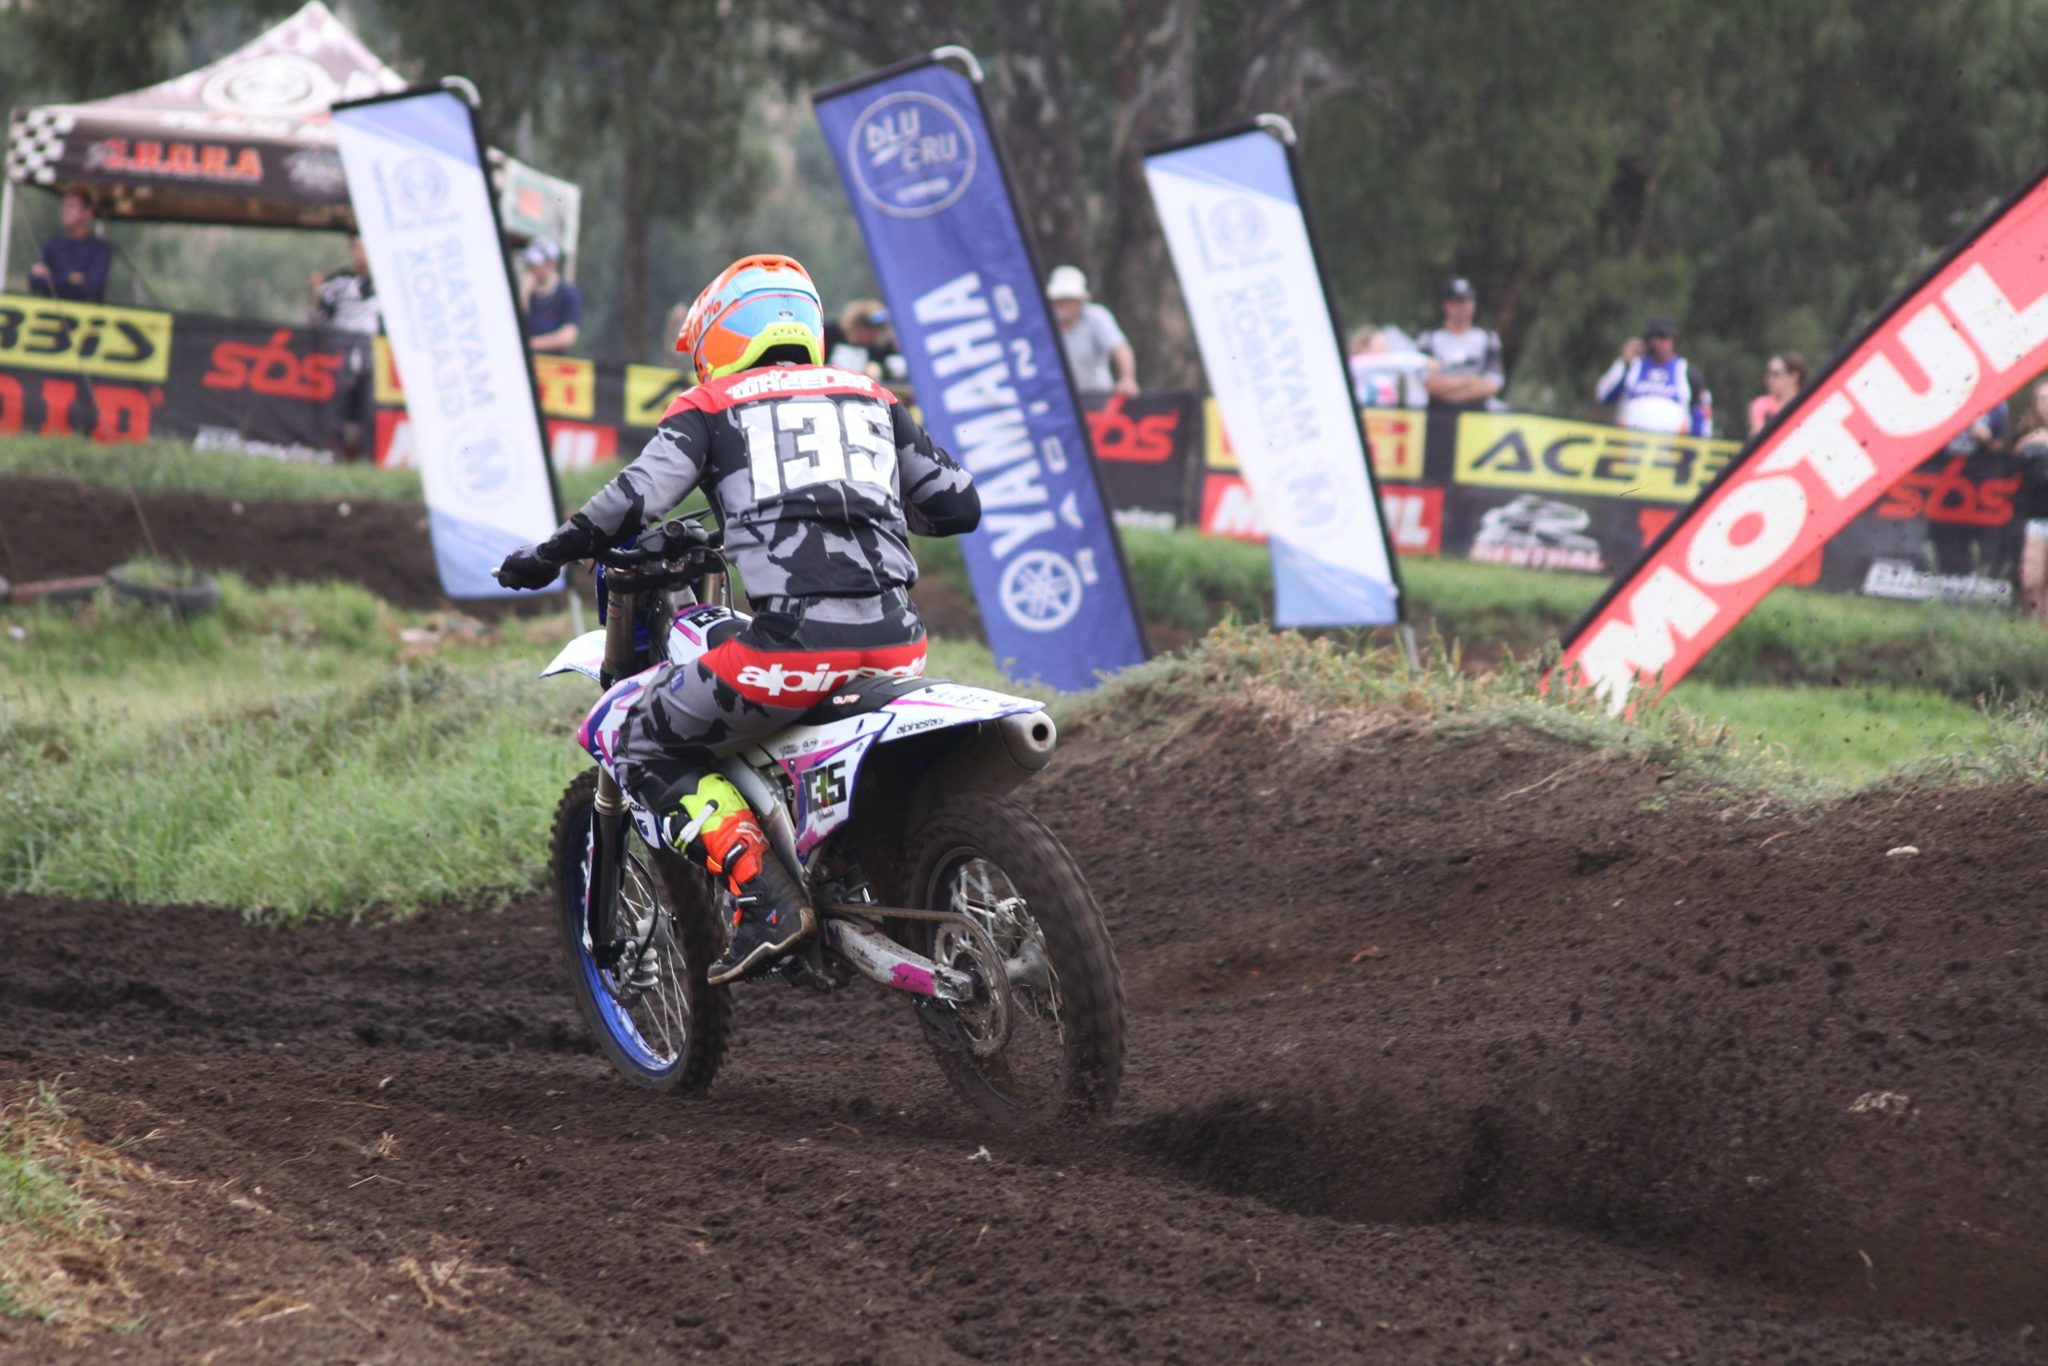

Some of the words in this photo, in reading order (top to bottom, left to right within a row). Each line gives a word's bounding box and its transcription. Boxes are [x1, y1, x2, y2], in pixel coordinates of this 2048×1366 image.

[203, 328, 343, 402] sbs
[739, 402, 898, 500] 135
[913, 271, 1056, 560] YAMAHA
[1086, 392, 1181, 464] bs
[1579, 262, 2048, 719] MOTUL
[737, 656, 927, 697] alpin
[896, 717, 945, 735] alpinestars
[802, 760, 847, 815] 135
